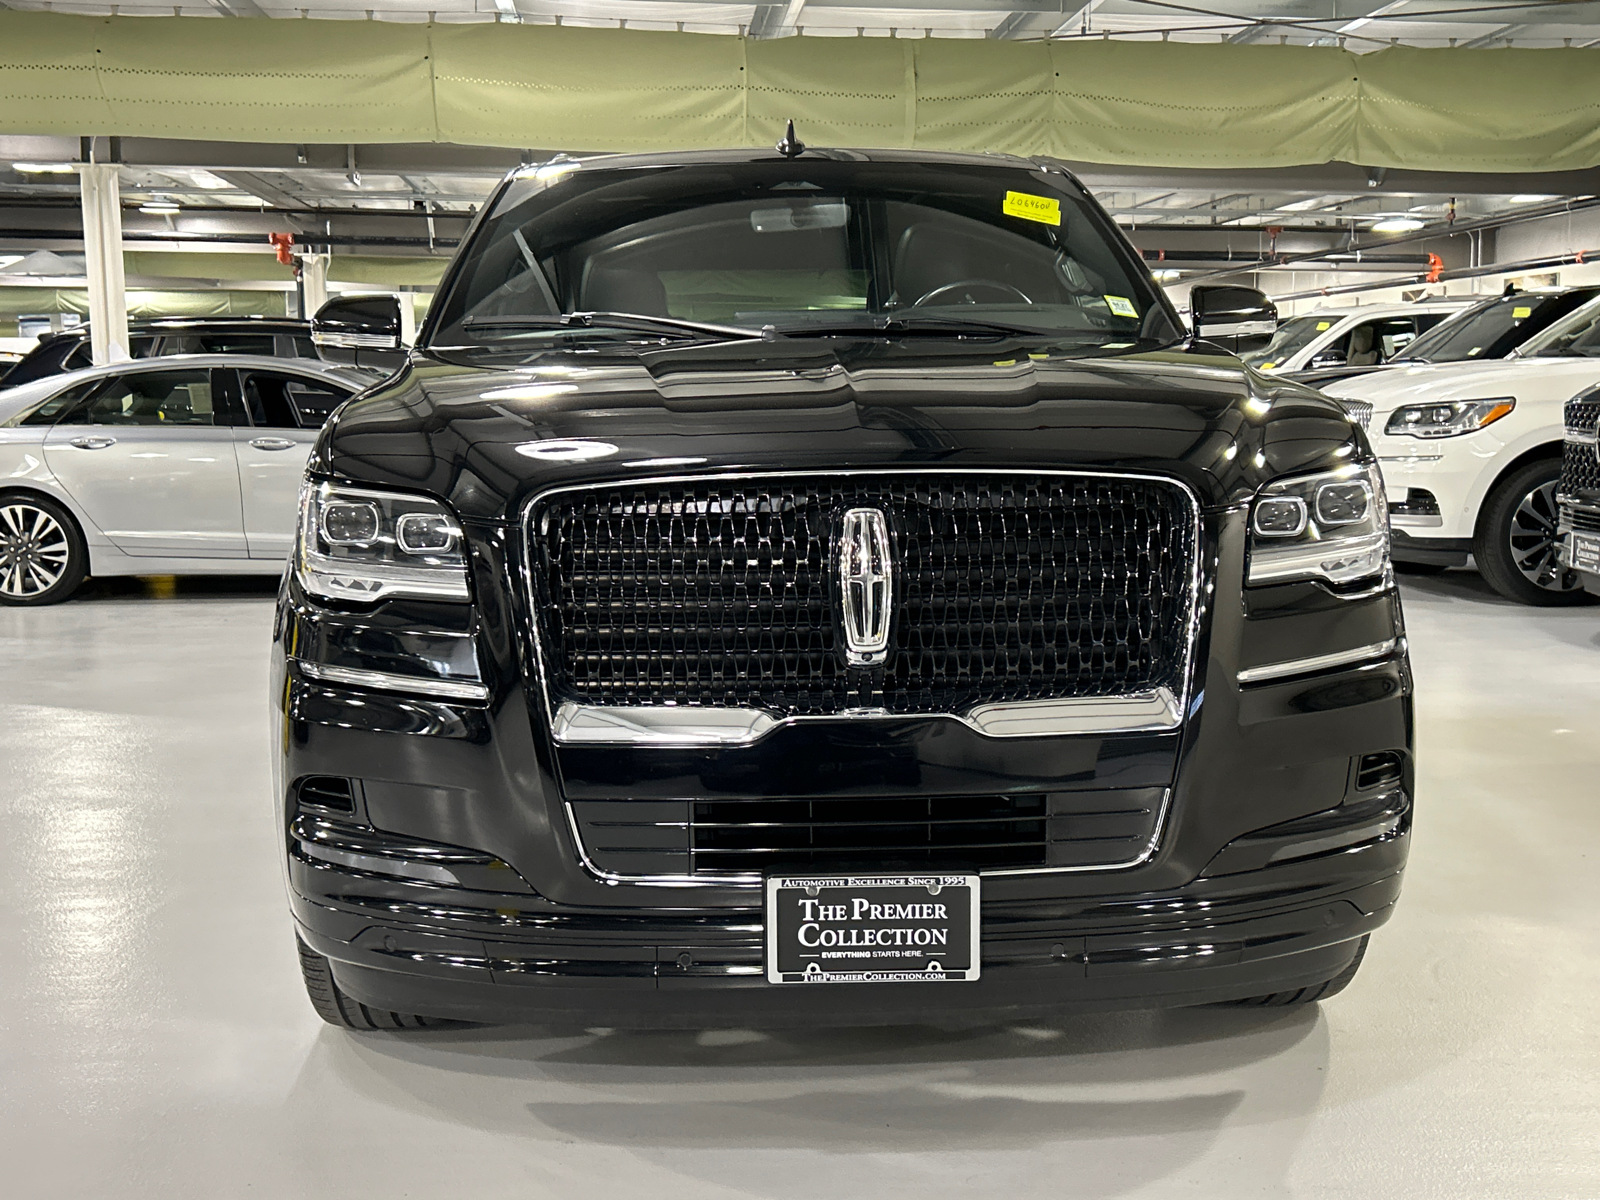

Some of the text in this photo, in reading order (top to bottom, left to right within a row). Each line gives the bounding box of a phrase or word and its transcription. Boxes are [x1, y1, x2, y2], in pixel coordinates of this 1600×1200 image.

[783, 876, 966, 888] AUTOMOTIVE EXCELLENCE SINCE 1995
[797, 898, 949, 921] THE PREMIER
[797, 922, 949, 948] COLLECTION
[821, 950, 924, 959] EVERYTHING STARTS HERE.
